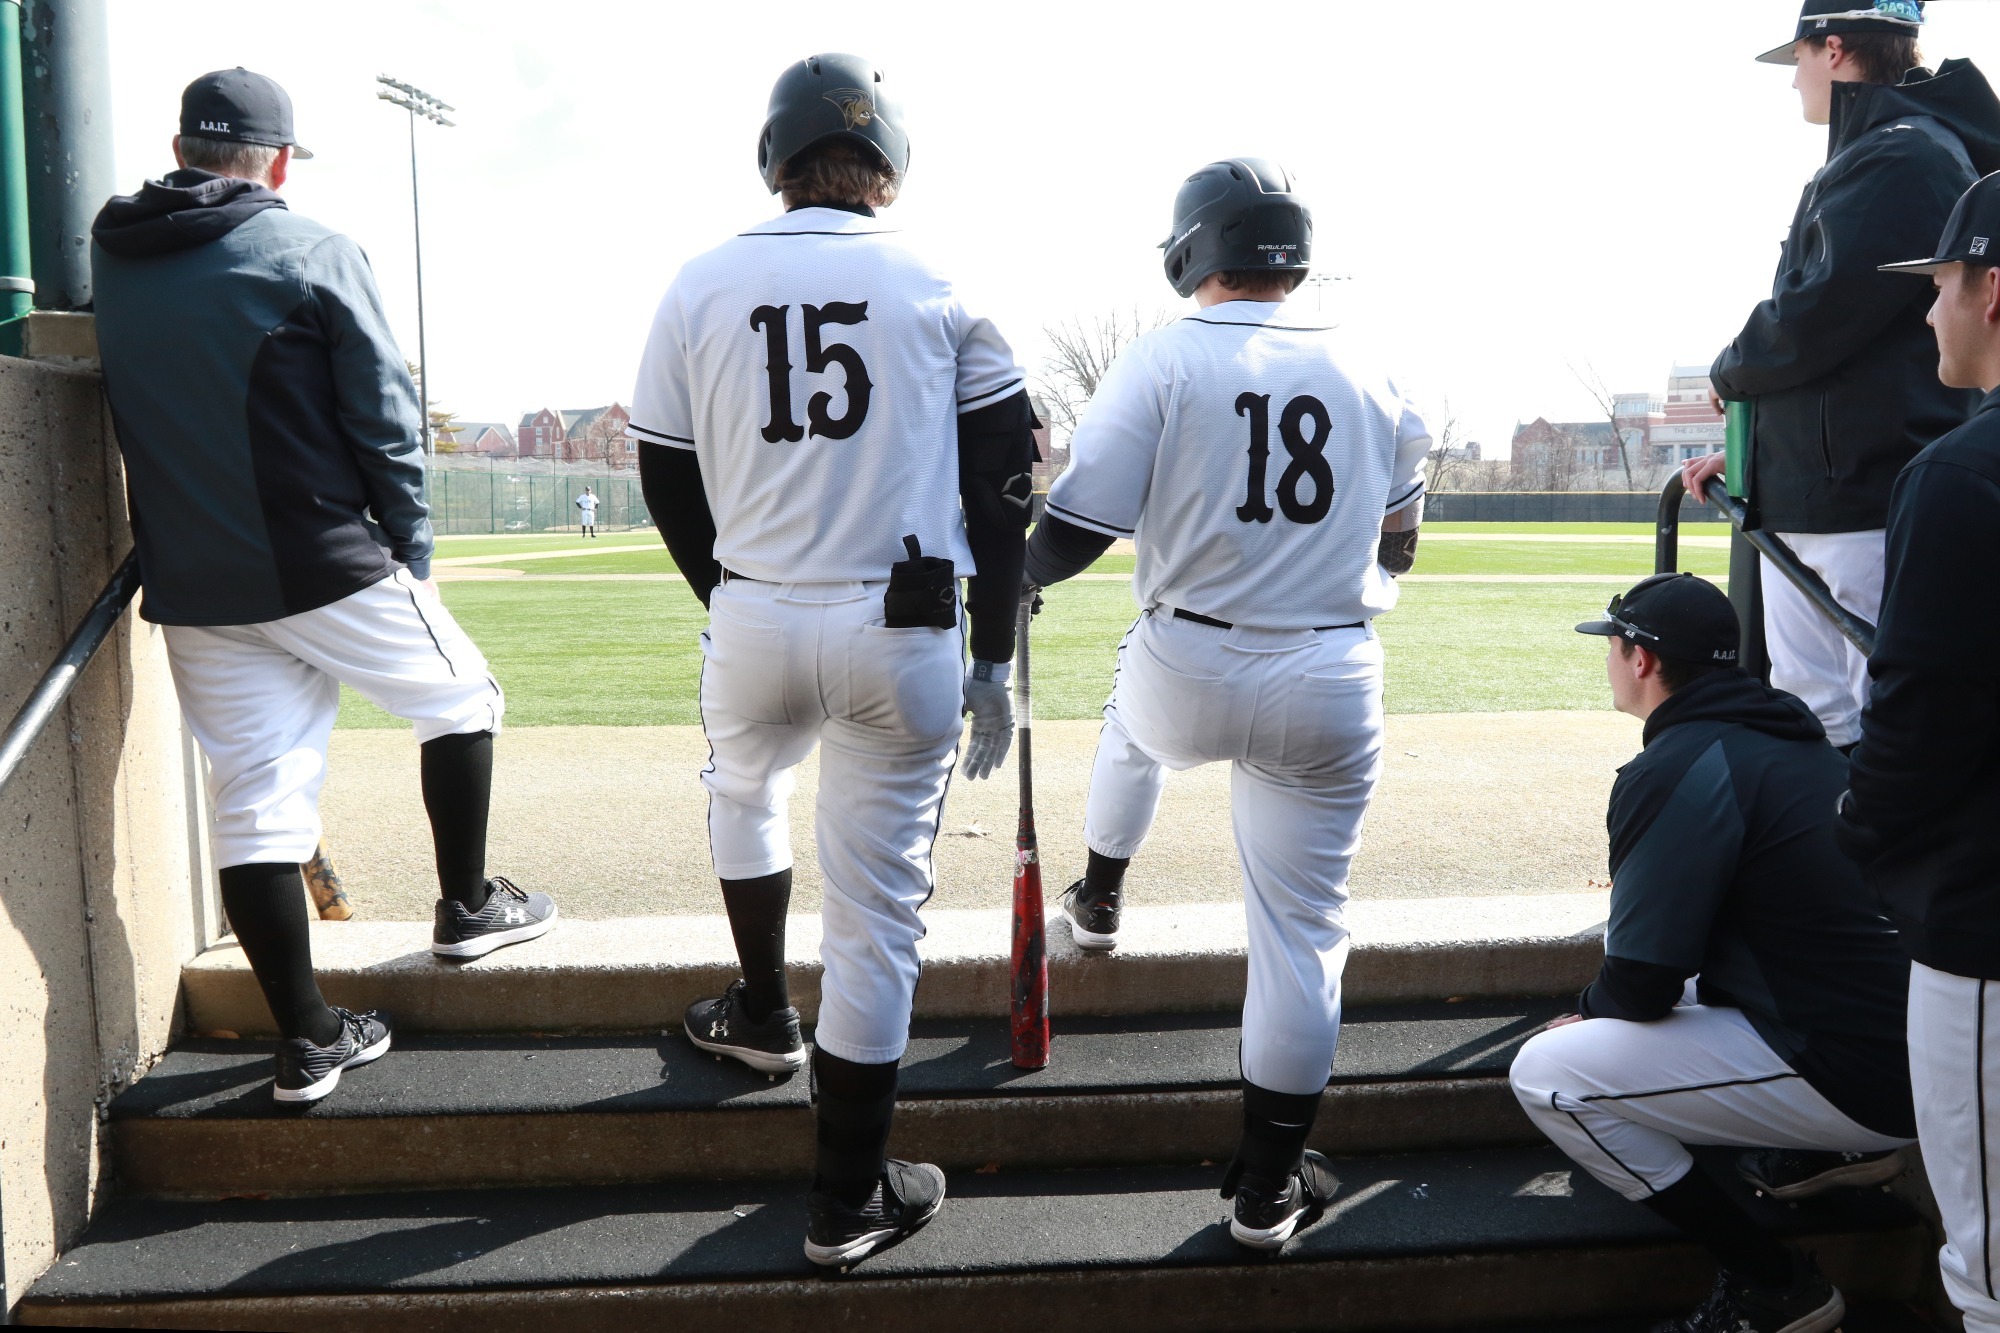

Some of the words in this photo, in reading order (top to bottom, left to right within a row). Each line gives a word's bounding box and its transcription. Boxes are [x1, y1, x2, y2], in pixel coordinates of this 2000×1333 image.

[200, 120, 230, 133] A.A.I.T.
[750, 300, 874, 443] 15
[1235, 391, 1335, 525] 18
